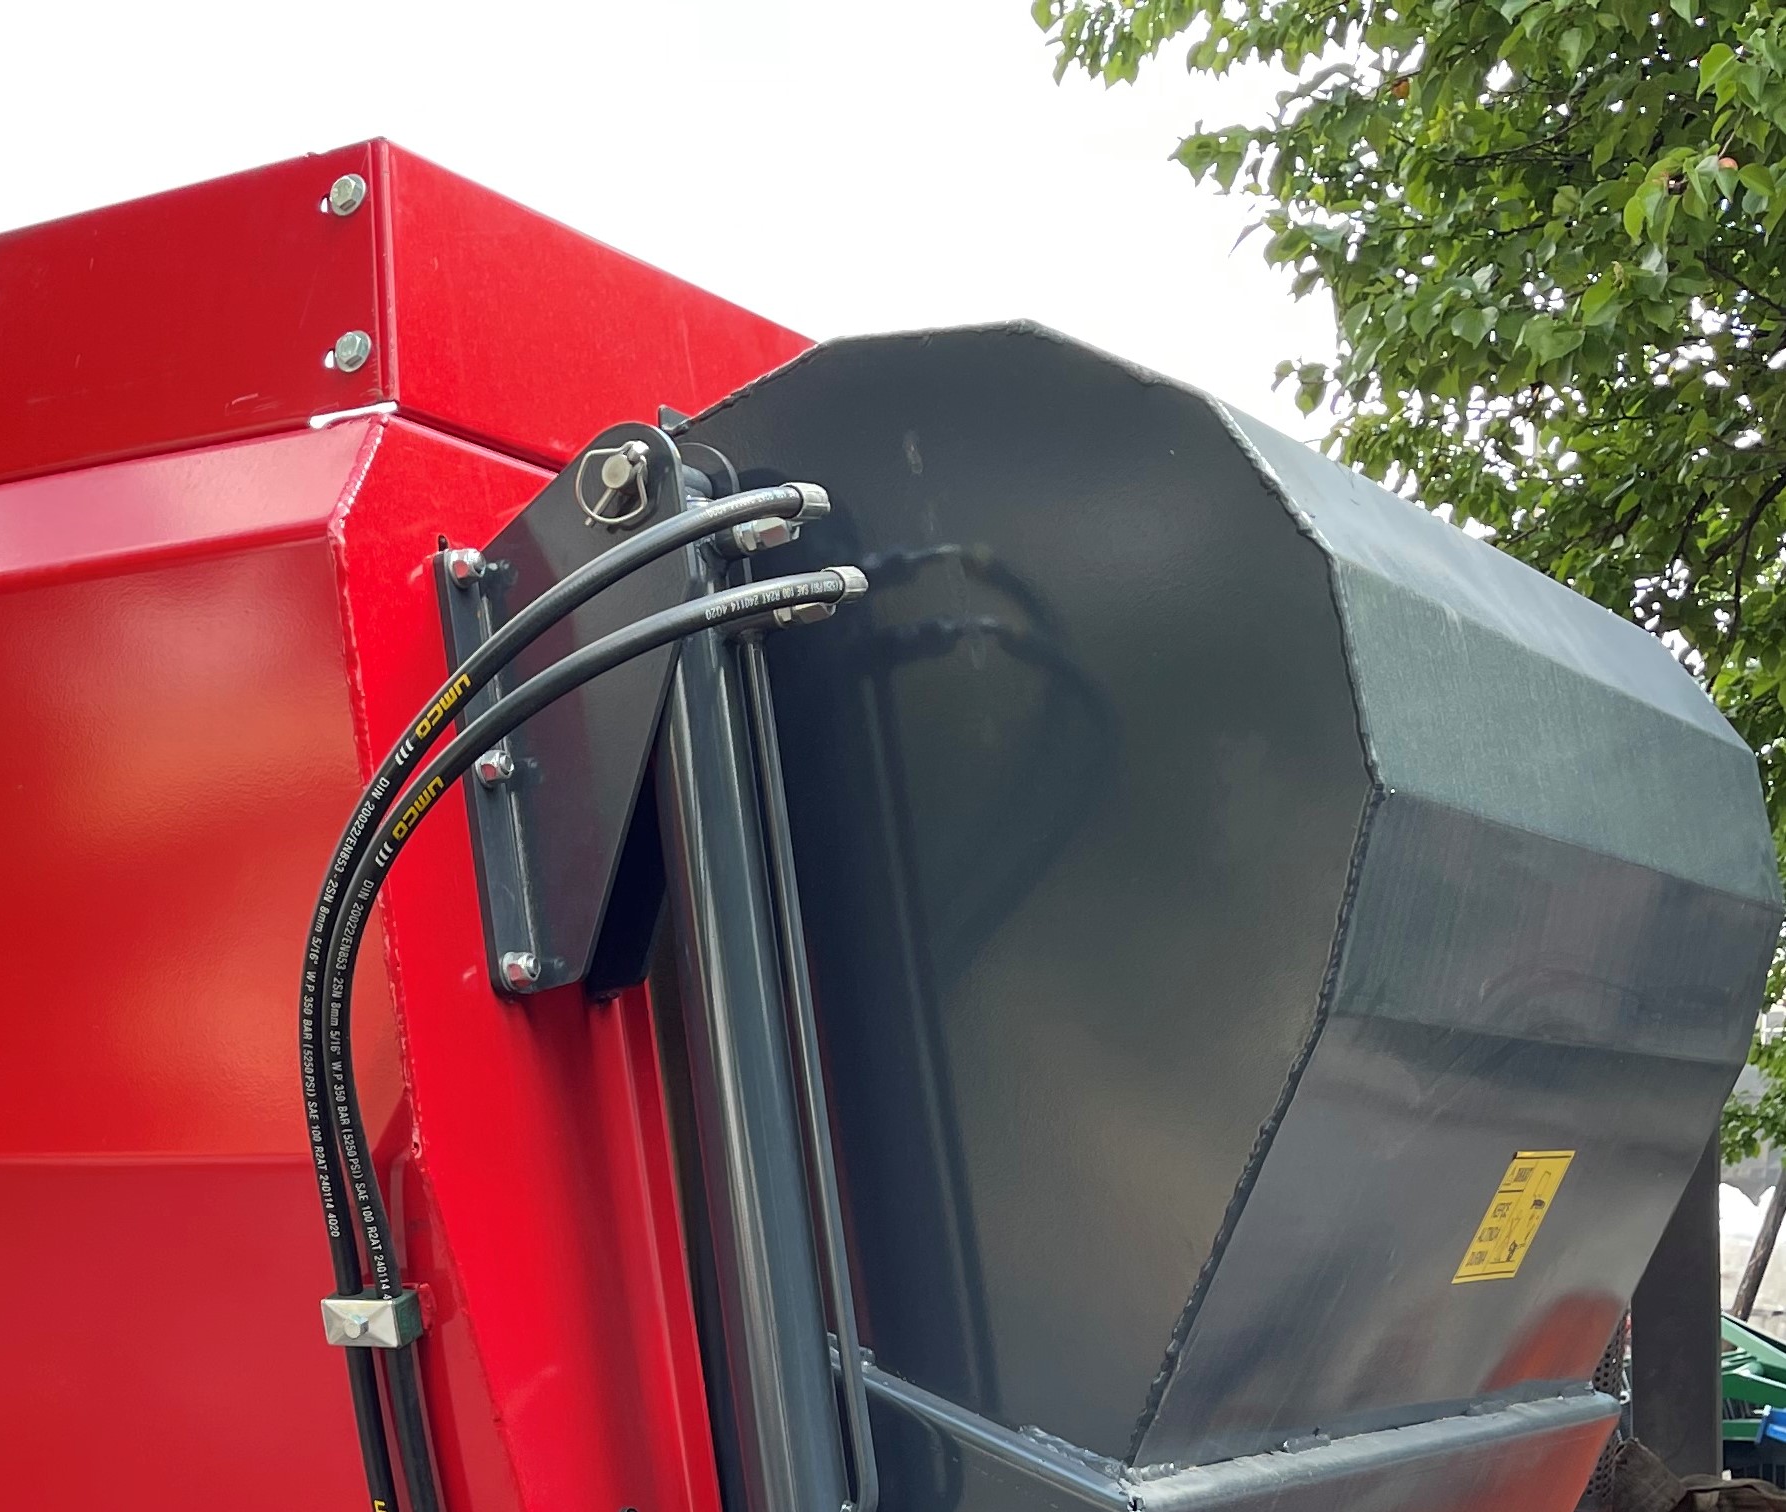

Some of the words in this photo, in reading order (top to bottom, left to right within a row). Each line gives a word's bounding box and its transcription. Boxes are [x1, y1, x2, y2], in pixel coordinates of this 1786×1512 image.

[371, 776, 391, 800] DIN
[357, 879, 374, 901] DIN
[303, 995, 314, 1015] 350
[329, 1001, 342, 1027] 8mm
[302, 1019, 314, 1041] BAR
[333, 1084, 346, 1102] 350
[307, 1101, 320, 1120] SAE
[337, 1105, 350, 1126] BAR
[311, 1124, 322, 1143] 100
[314, 1146, 328, 1170] R2AT
[319, 1174, 335, 1209] 240114
[354, 1182, 369, 1201] SAE
[361, 1205, 374, 1223] 100
[366, 1225, 383, 1251] R2AT
[374, 1254, 391, 1290] 240114
